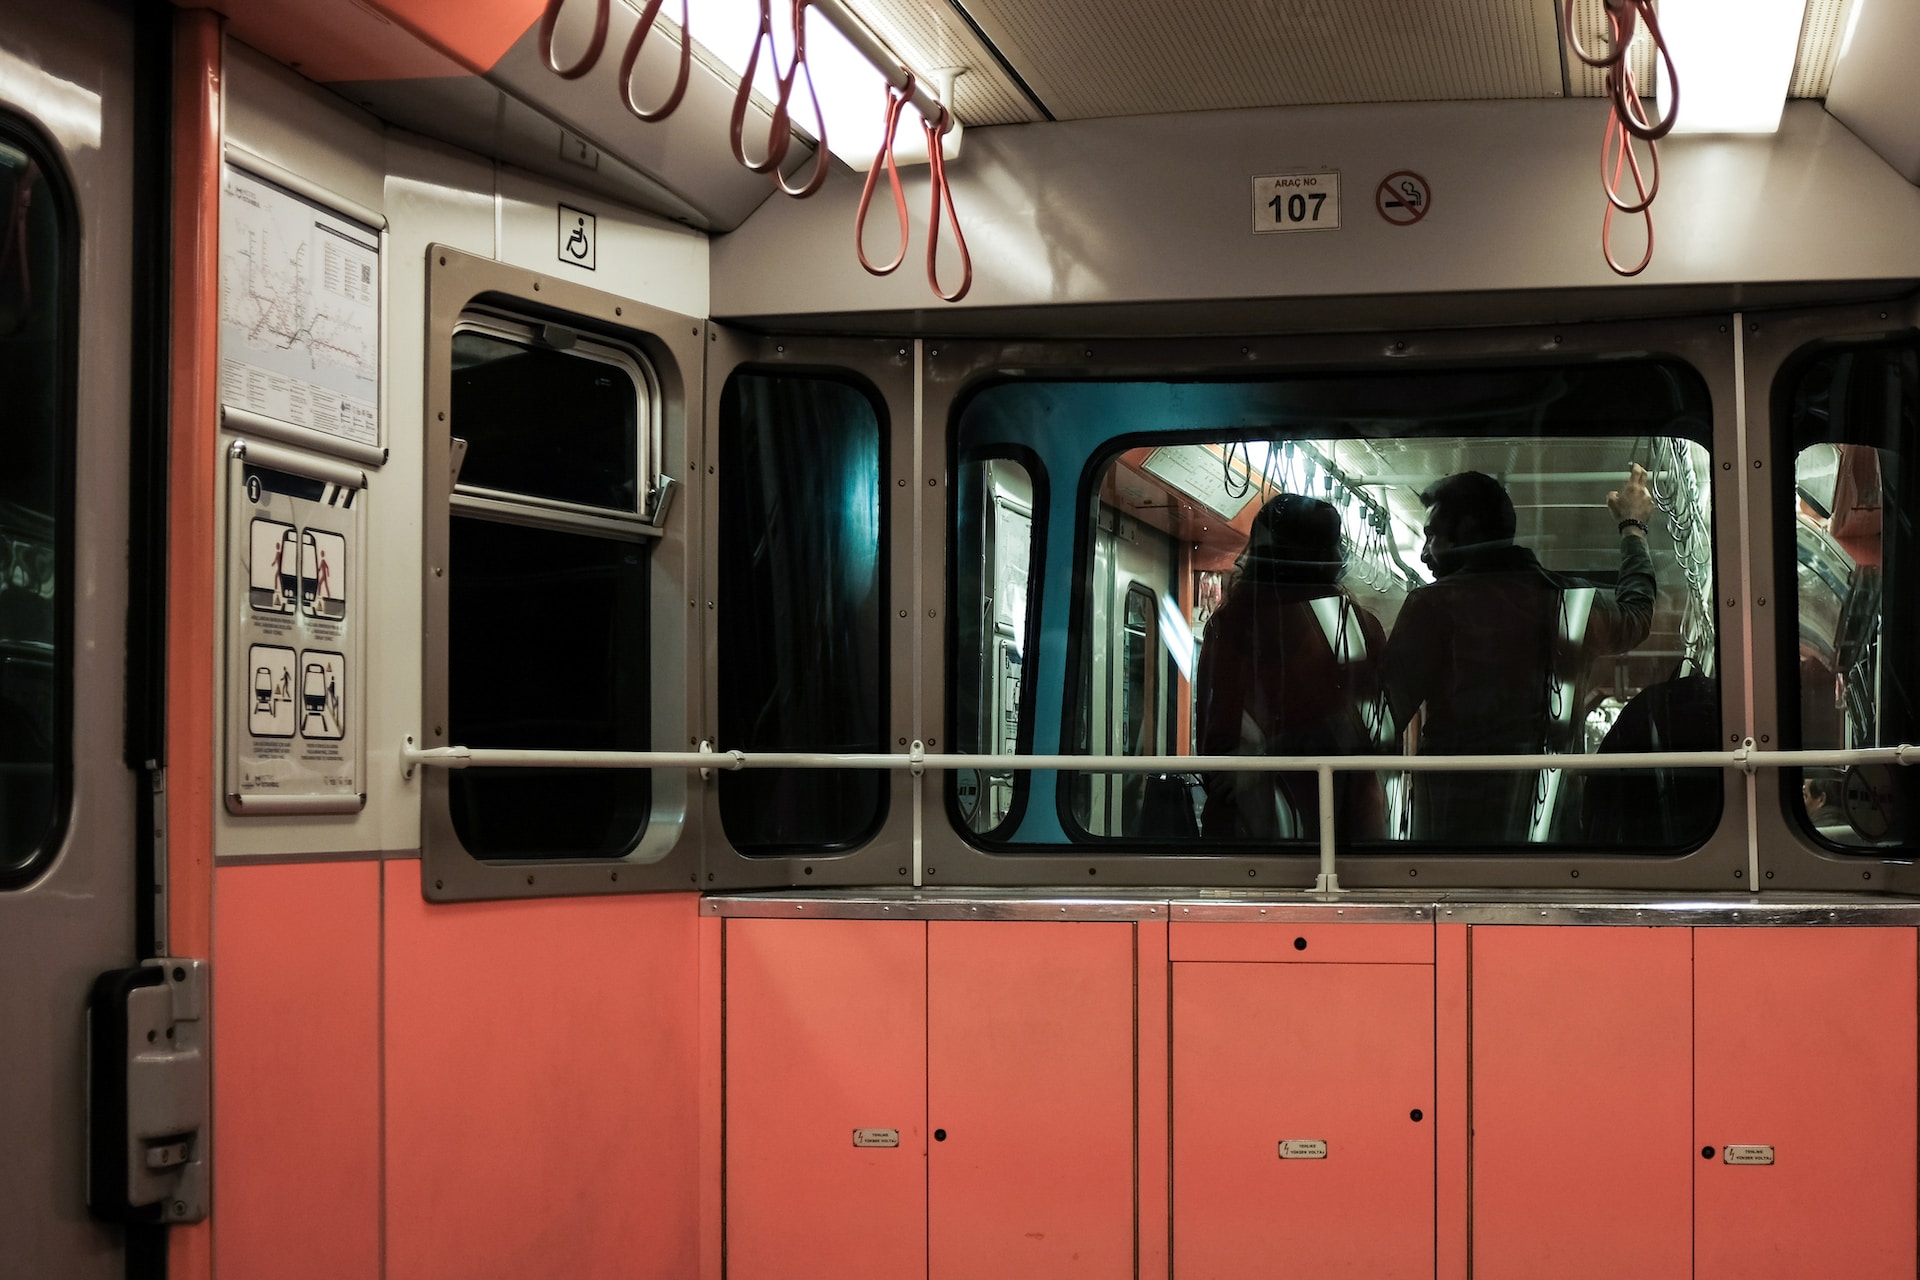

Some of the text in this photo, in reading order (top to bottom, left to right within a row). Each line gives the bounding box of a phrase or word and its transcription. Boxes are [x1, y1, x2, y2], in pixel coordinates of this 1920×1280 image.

[1275, 178, 1318, 188] ARAÇ NO
[1268, 193, 1327, 223] 107
